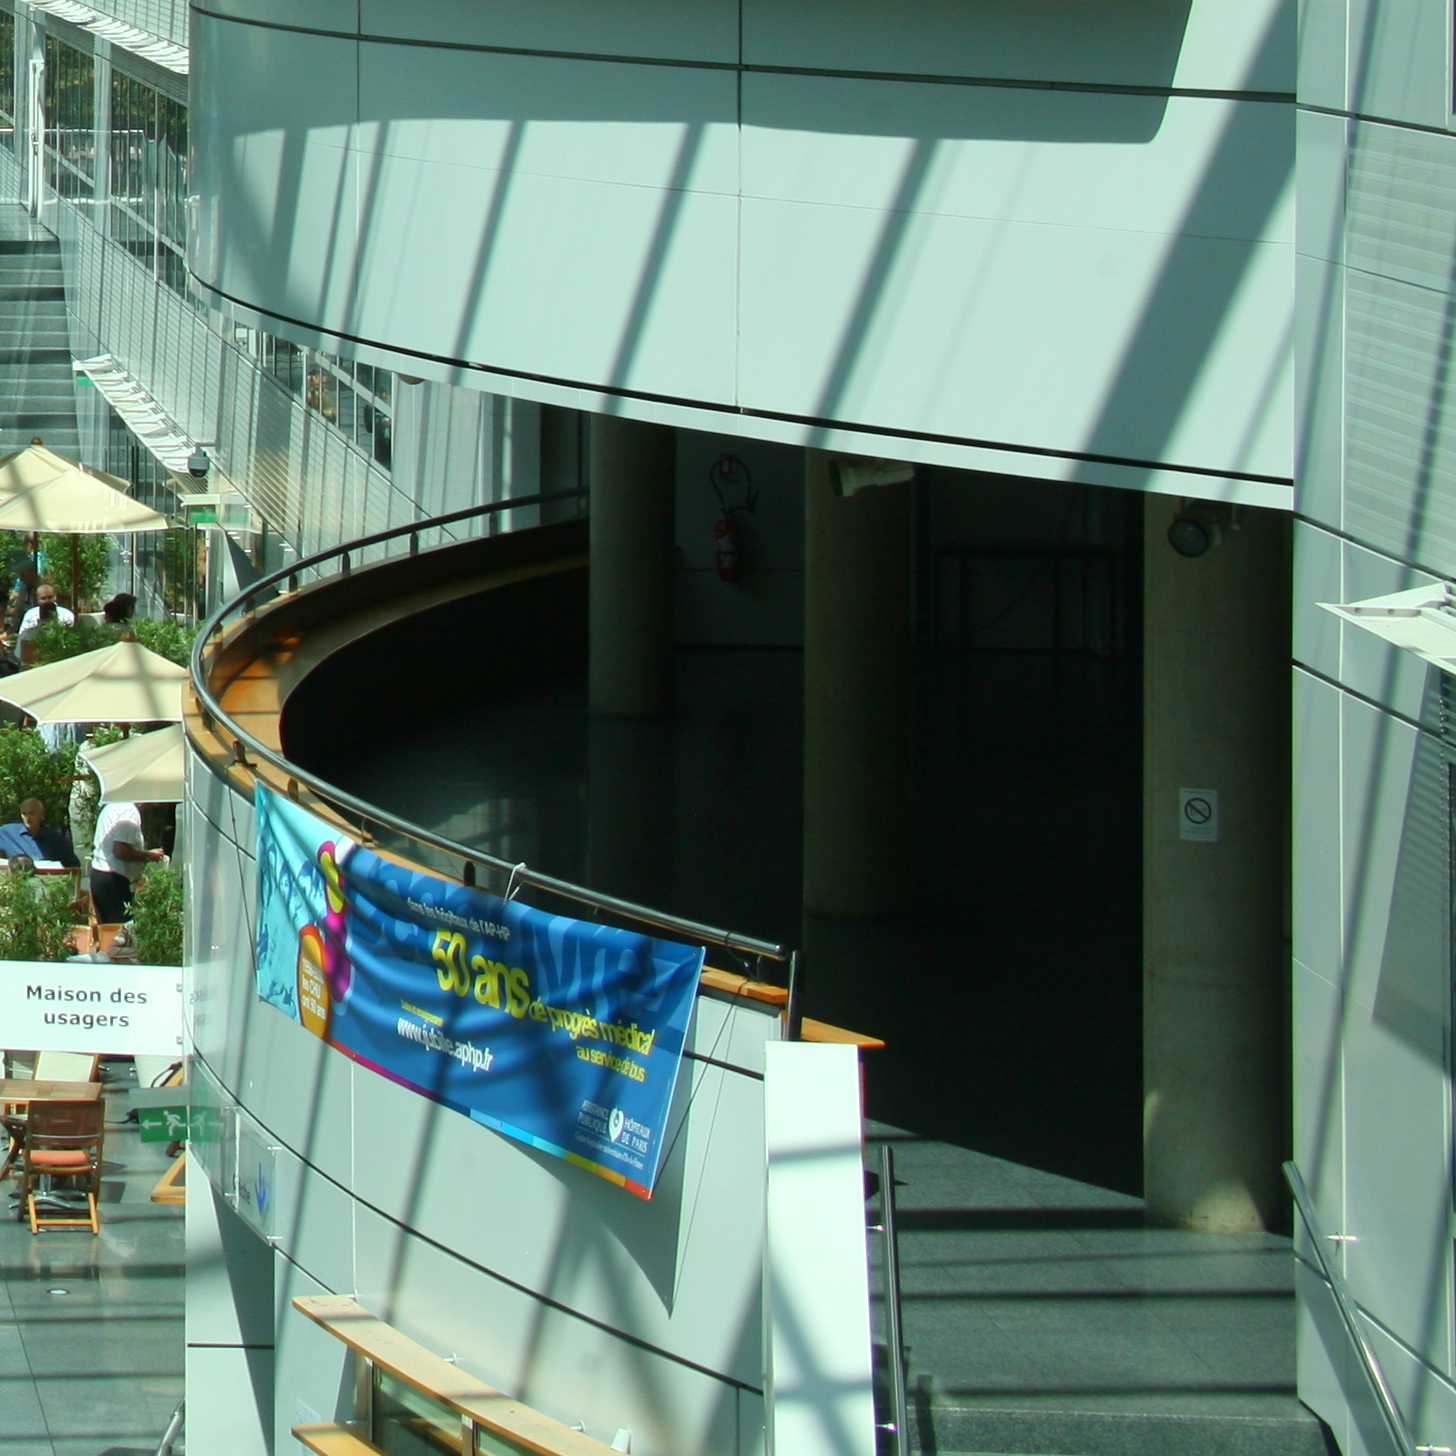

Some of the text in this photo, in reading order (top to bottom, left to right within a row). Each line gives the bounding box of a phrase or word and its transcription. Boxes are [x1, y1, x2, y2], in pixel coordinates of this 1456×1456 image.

[26, 985, 147, 1004] Maison des
[432, 928, 470, 997] 50
[471, 954, 530, 1019] ans
[547, 1006, 600, 1040] progrès
[599, 1019, 655, 1056] médical
[44, 1012, 129, 1029] usagers
[575, 1045, 590, 1061] au
